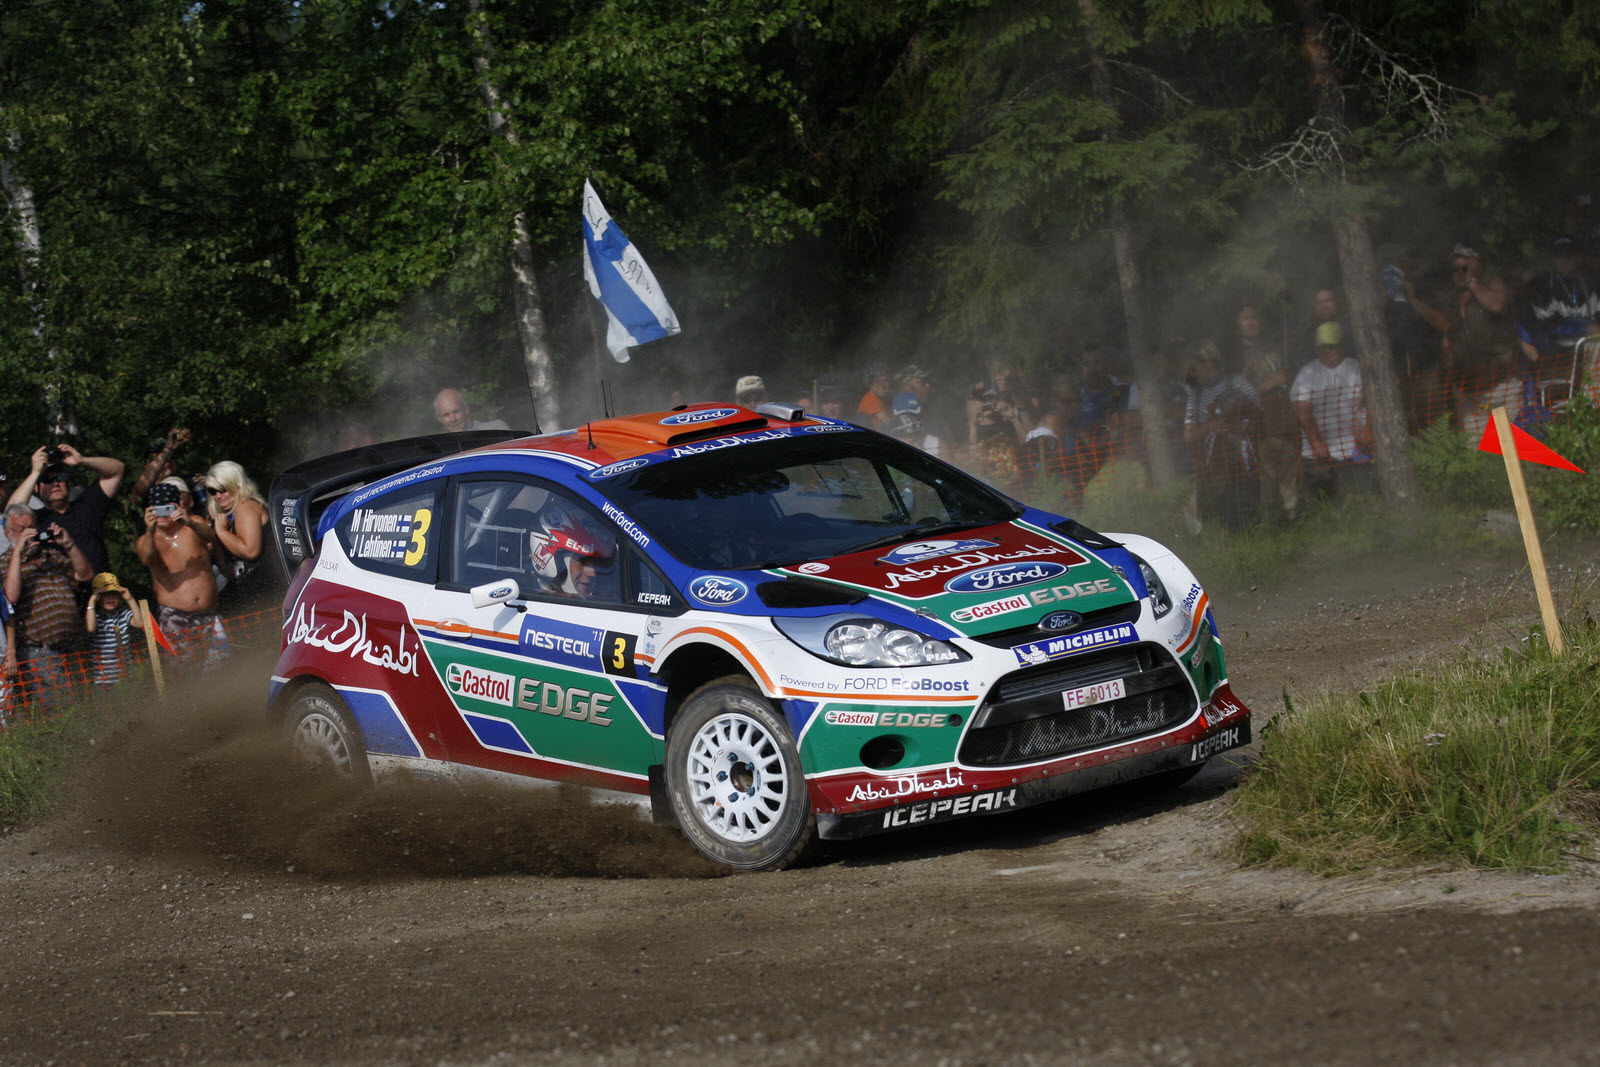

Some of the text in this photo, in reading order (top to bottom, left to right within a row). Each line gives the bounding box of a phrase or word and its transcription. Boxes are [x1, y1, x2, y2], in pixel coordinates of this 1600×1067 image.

[676, 408, 727, 425] Ford
[812, 425, 846, 433] Ford
[601, 460, 640, 476] Ford
[352, 463, 447, 506] Ford recommends Castrol
[351, 508, 398, 533] M Hirvonen
[602, 501, 650, 549] wrcford.com
[349, 535, 393, 559] J Lehtinen
[404, 507, 433, 567] 3
[697, 577, 739, 601] Ford
[970, 564, 1050, 590] Ford
[492, 588, 509, 598] Ford
[637, 592, 672, 606] ICEPEAK
[970, 577, 1119, 620] Castrol EDGE
[1050, 613, 1075, 628] Ford
[1047, 626, 1132, 653] MICHELIN
[612, 637, 627, 670] 3
[926, 652, 960, 662] PIAA
[780, 673, 970, 692] Powered by FORD EcoBoost
[461, 669, 617, 729] Castrol EDGE
[1066, 682, 1121, 709] FE-6013
[837, 711, 950, 728] Castrol EDGE
[1191, 726, 1239, 762] ICEPEAK
[895, 767, 965, 797] Dhabi
[882, 789, 1018, 829] ICEPEAK
